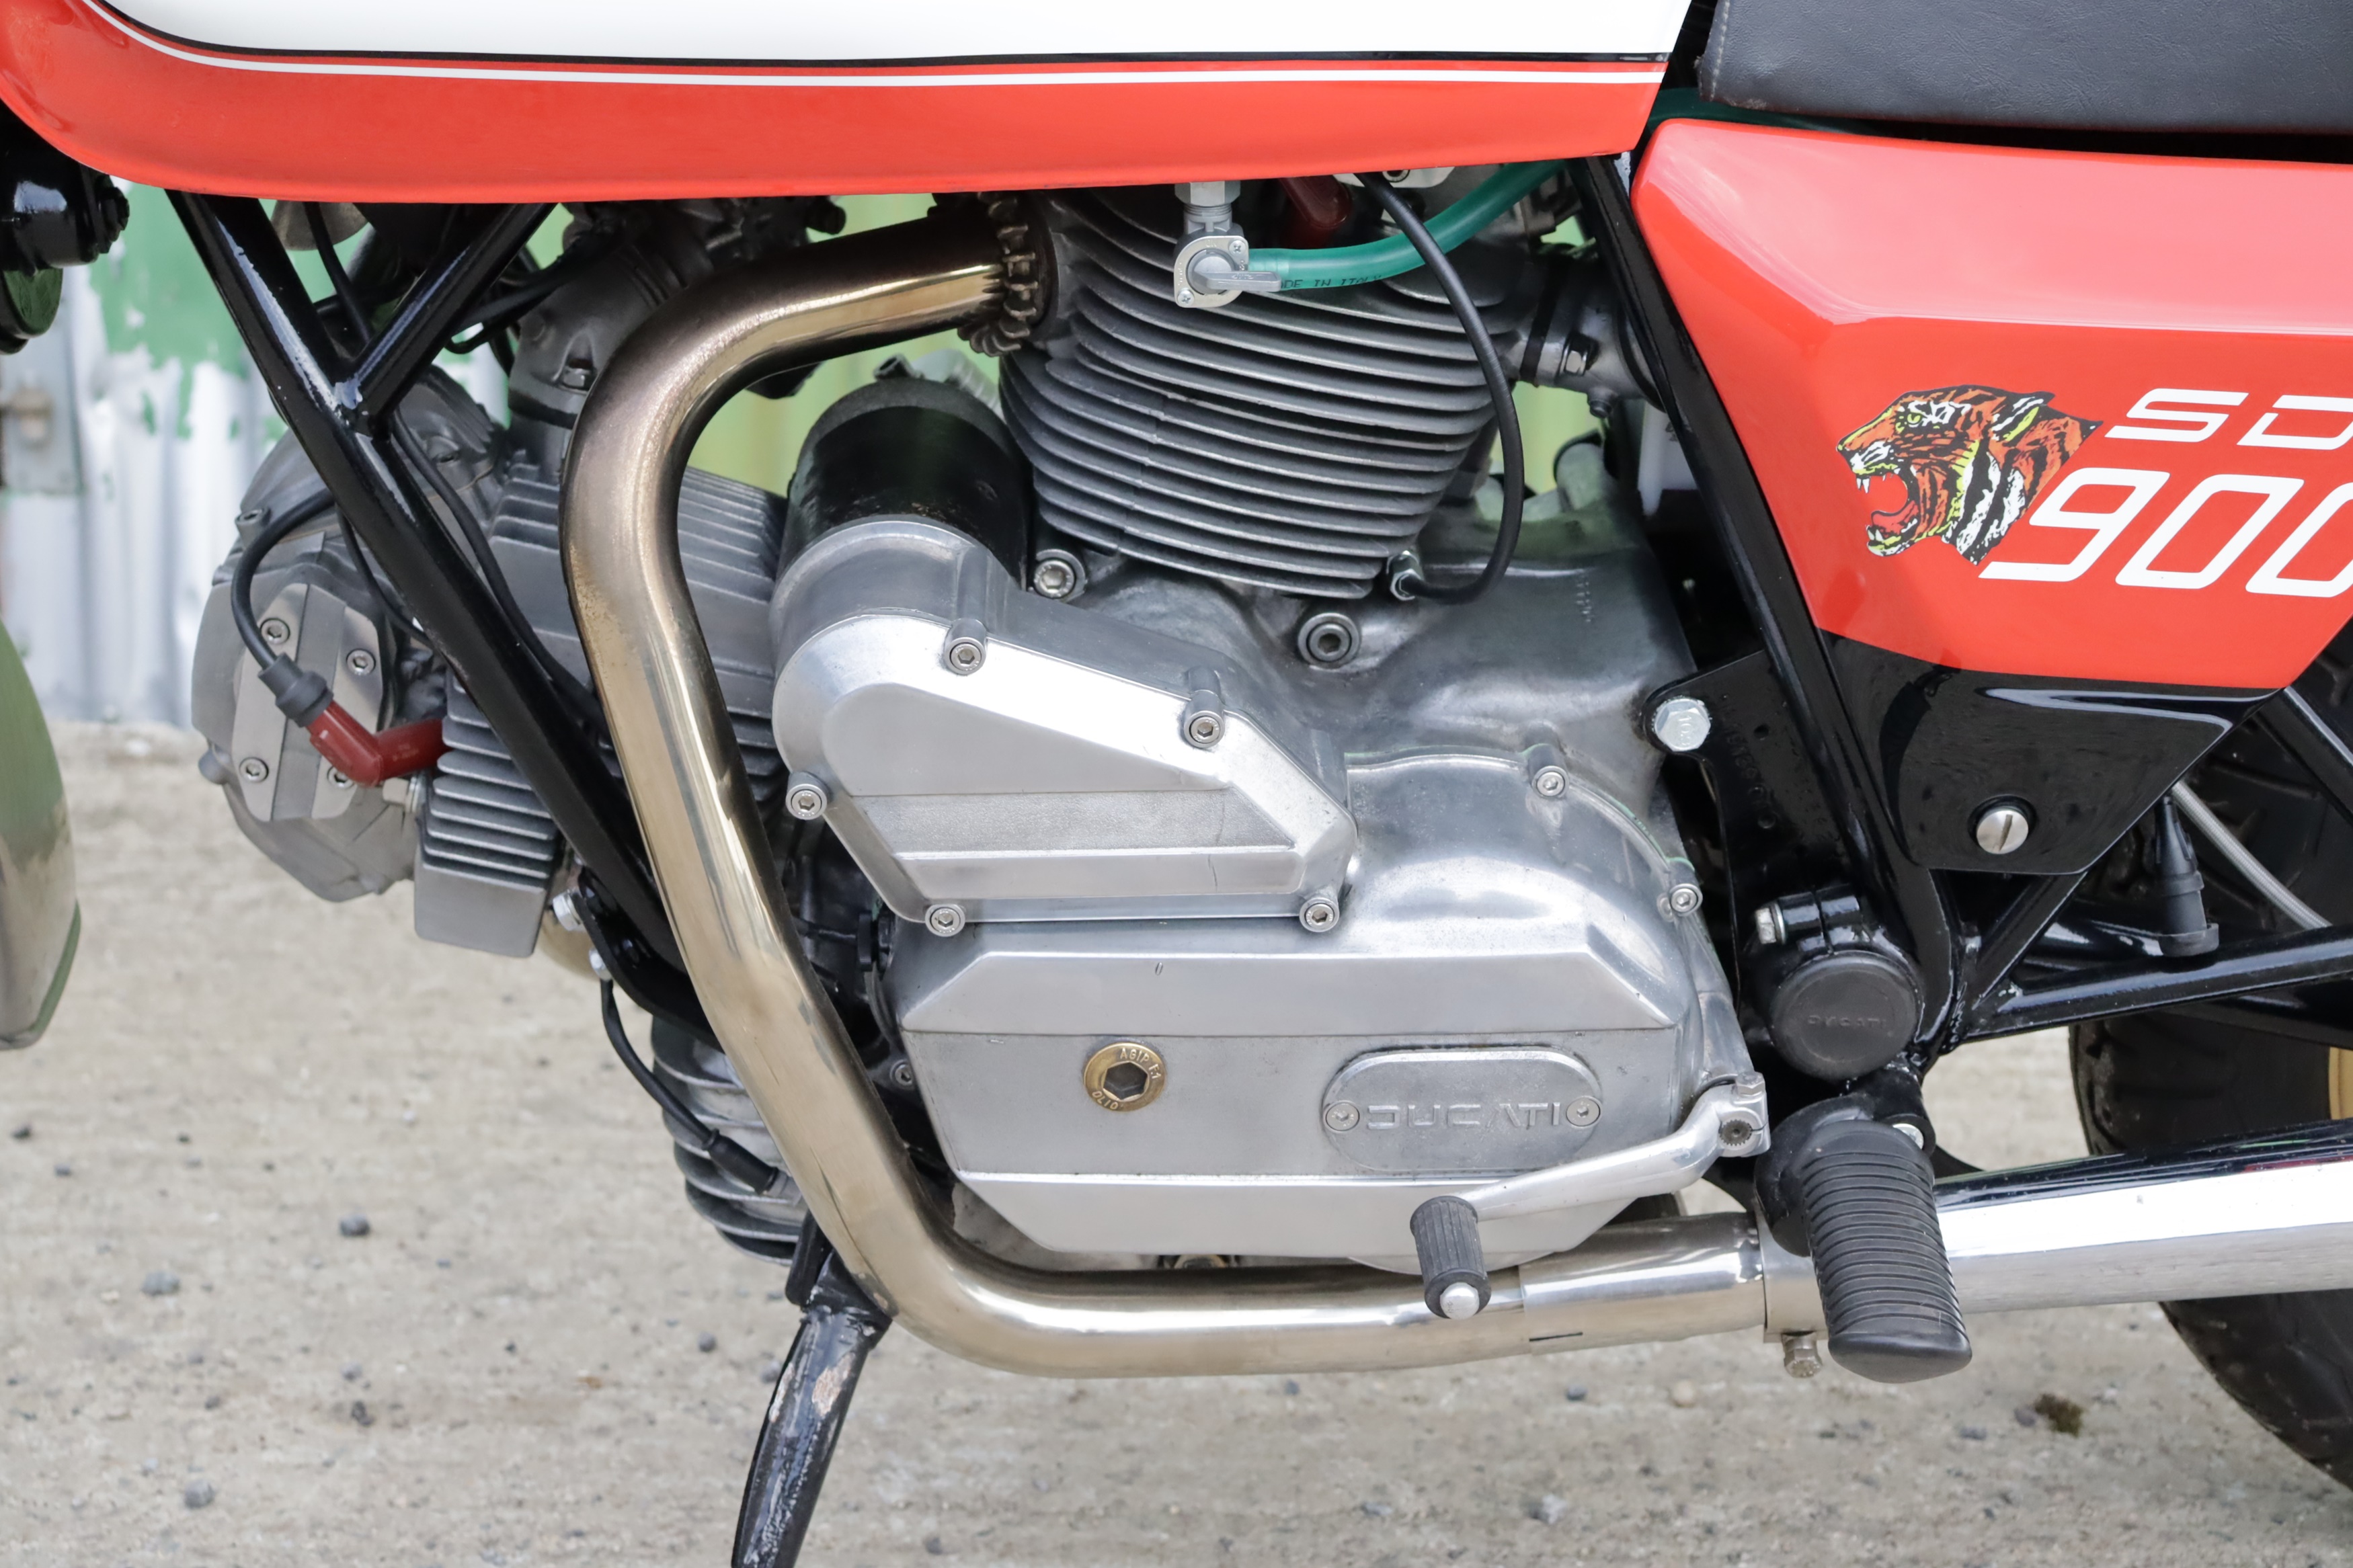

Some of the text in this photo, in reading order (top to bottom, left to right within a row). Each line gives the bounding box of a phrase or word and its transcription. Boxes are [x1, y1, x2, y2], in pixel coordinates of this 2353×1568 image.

[1281, 279, 1304, 289] DE
[1314, 278, 1332, 288] IN
[1119, 1046, 1150, 1063] AGIP
[1092, 1090, 1119, 1110] OLIO
[1367, 1102, 1560, 1130] DUCATI
